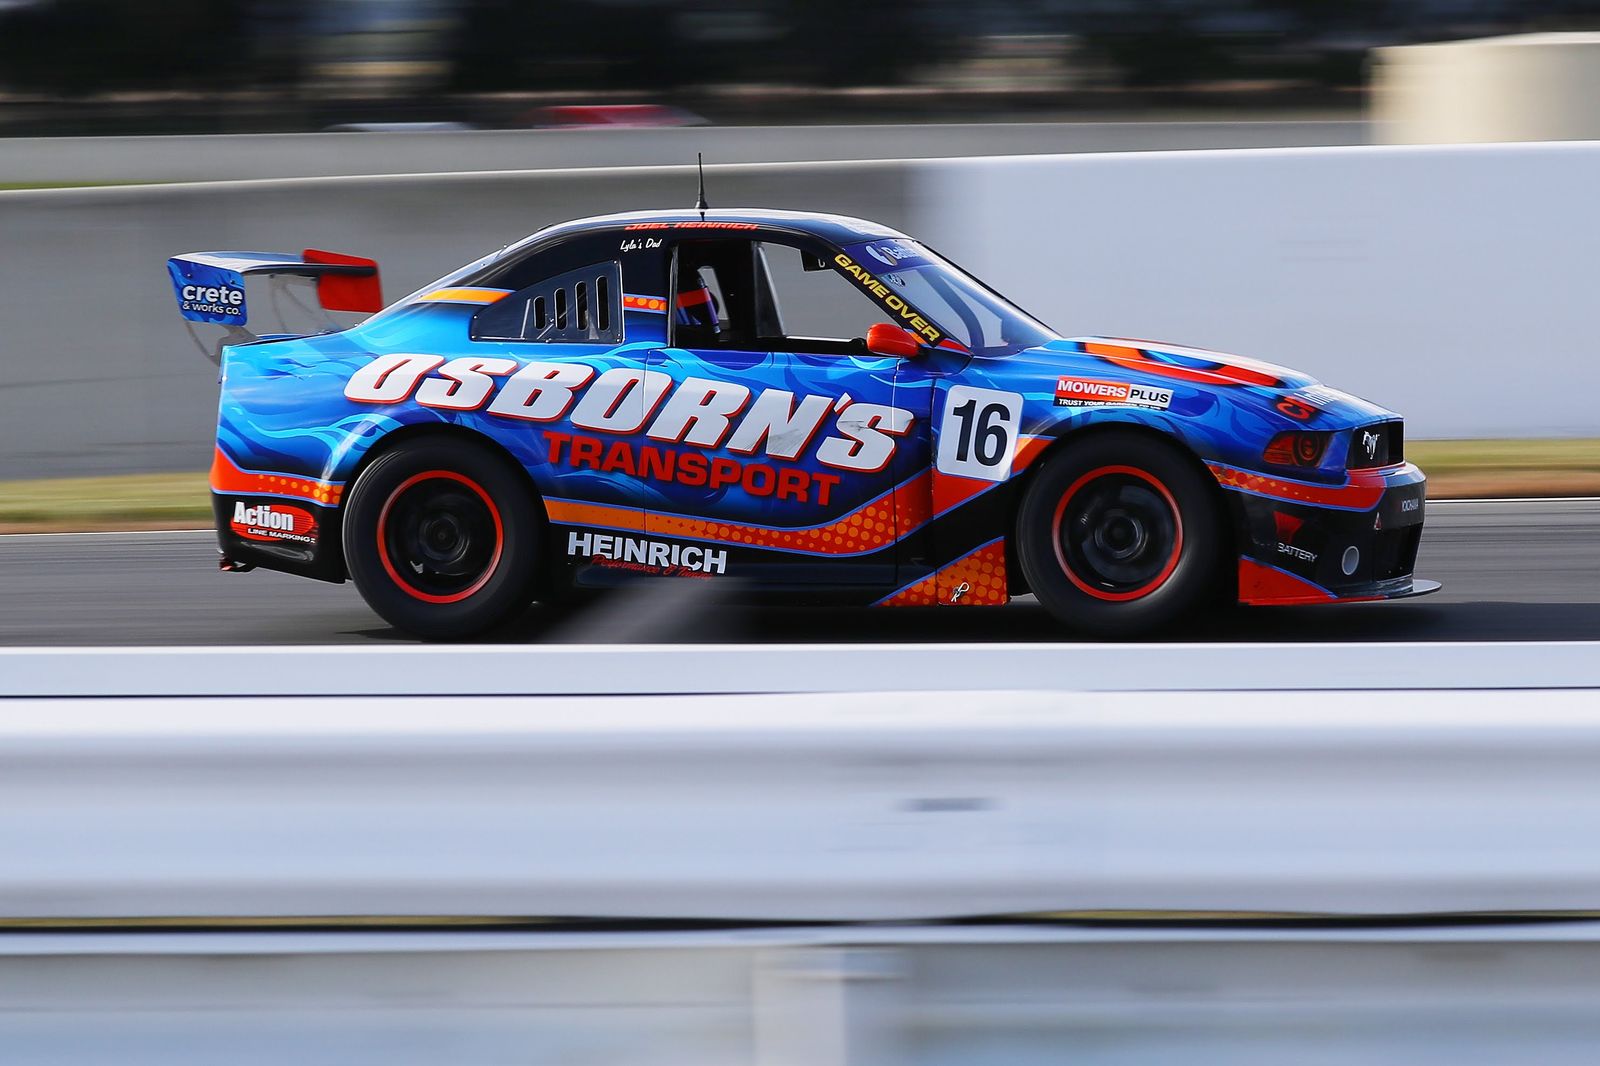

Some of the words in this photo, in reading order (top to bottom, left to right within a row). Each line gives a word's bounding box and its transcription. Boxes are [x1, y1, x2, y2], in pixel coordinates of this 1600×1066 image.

[624, 222, 670, 230] JOEL
[673, 221, 759, 230] HEINRICH
[620, 238, 643, 252] Lyla's
[645, 238, 662, 249] Dad
[182, 285, 243, 305] crete
[834, 253, 891, 299] GAME
[885, 295, 940, 342] OVER
[183, 301, 190, 310] &
[192, 303, 224, 314] works
[226, 306, 241, 316] co.
[1057, 380, 1128, 398] MOWERS
[1129, 389, 1169, 404] PLUS
[1059, 398, 1083, 406] TRUST
[344, 353, 914, 474] OSBORN'S
[952, 399, 1011, 467] 16
[543, 431, 840, 506] TRANSPORT
[233, 501, 294, 531] Action
[247, 528, 268, 536] LINE
[567, 531, 728, 574] HEINRICH
[1278, 542, 1318, 562] BATTERY
